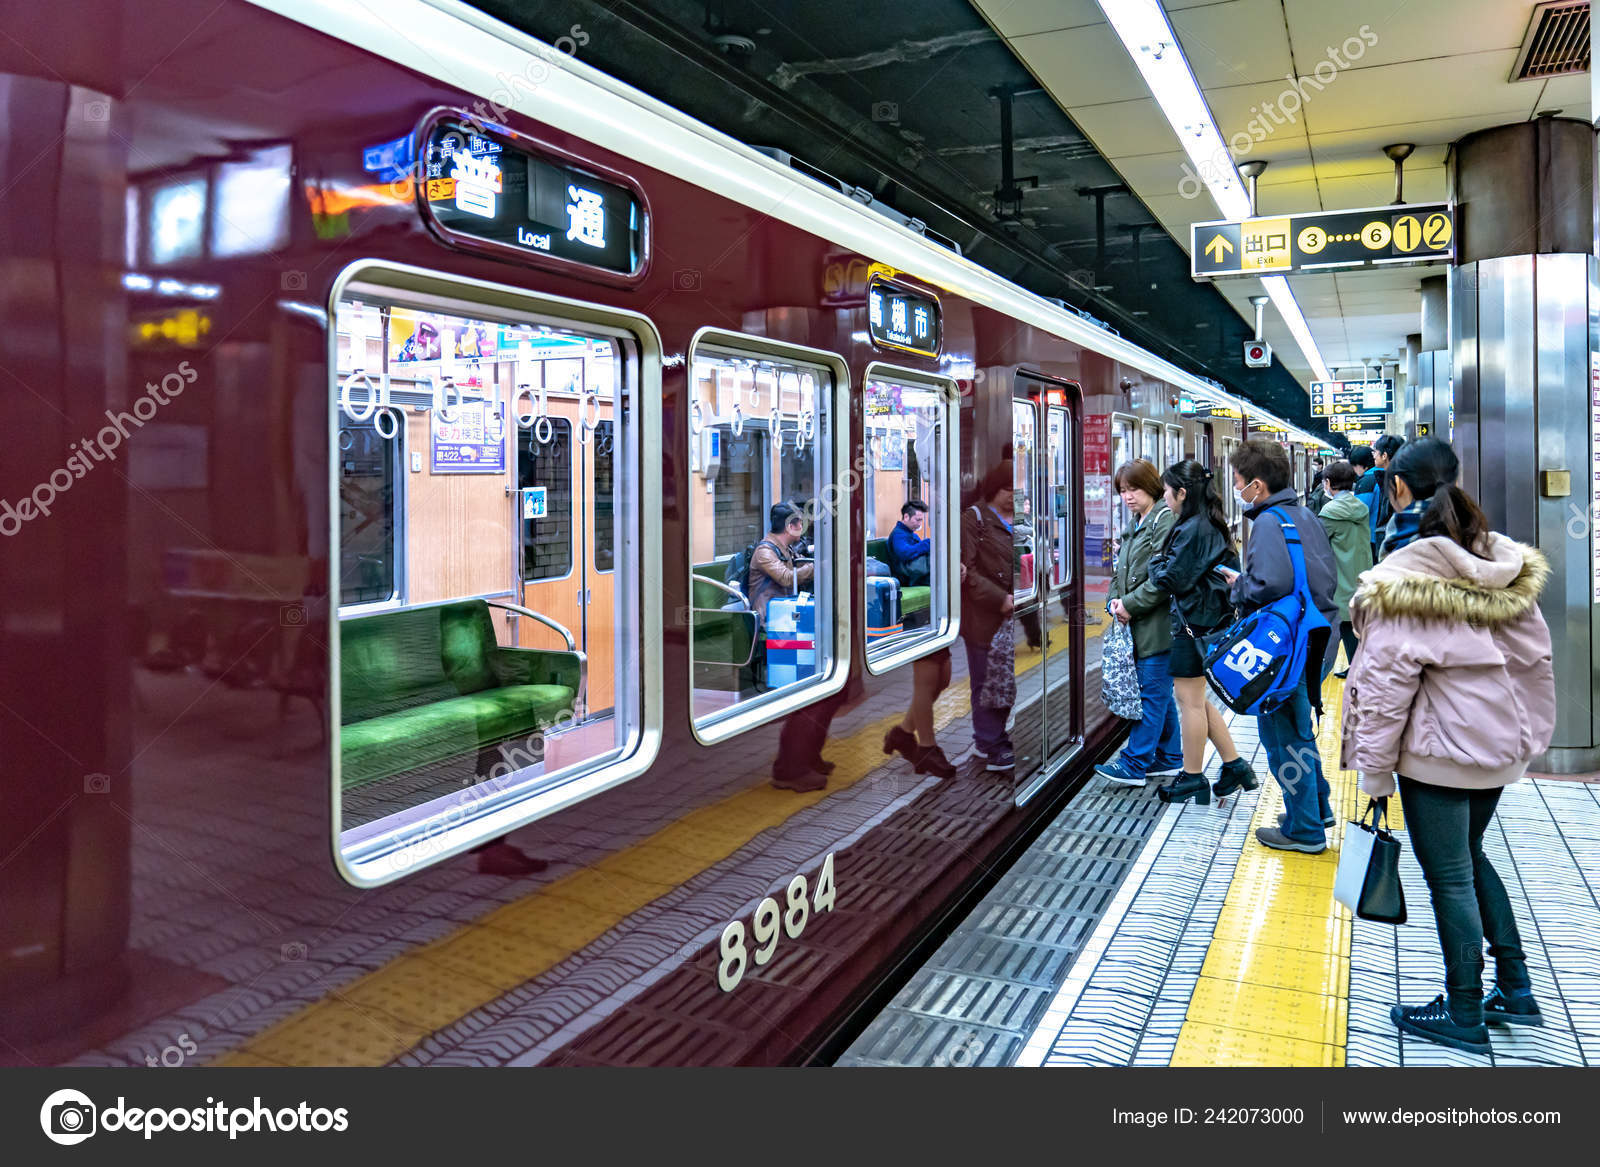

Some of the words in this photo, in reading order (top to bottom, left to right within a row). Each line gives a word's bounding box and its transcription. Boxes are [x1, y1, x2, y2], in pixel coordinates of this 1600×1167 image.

[450, 148, 605, 248] 普通
[518, 227, 551, 251] Local
[1245, 233, 1287, 254] 出口
[1306, 233, 1319, 248] 3
[1370, 229, 1383, 242] 6
[1256, 257, 1275, 266] Exit
[870, 290, 928, 339] 高槻市
[718, 852, 837, 993] 8984
